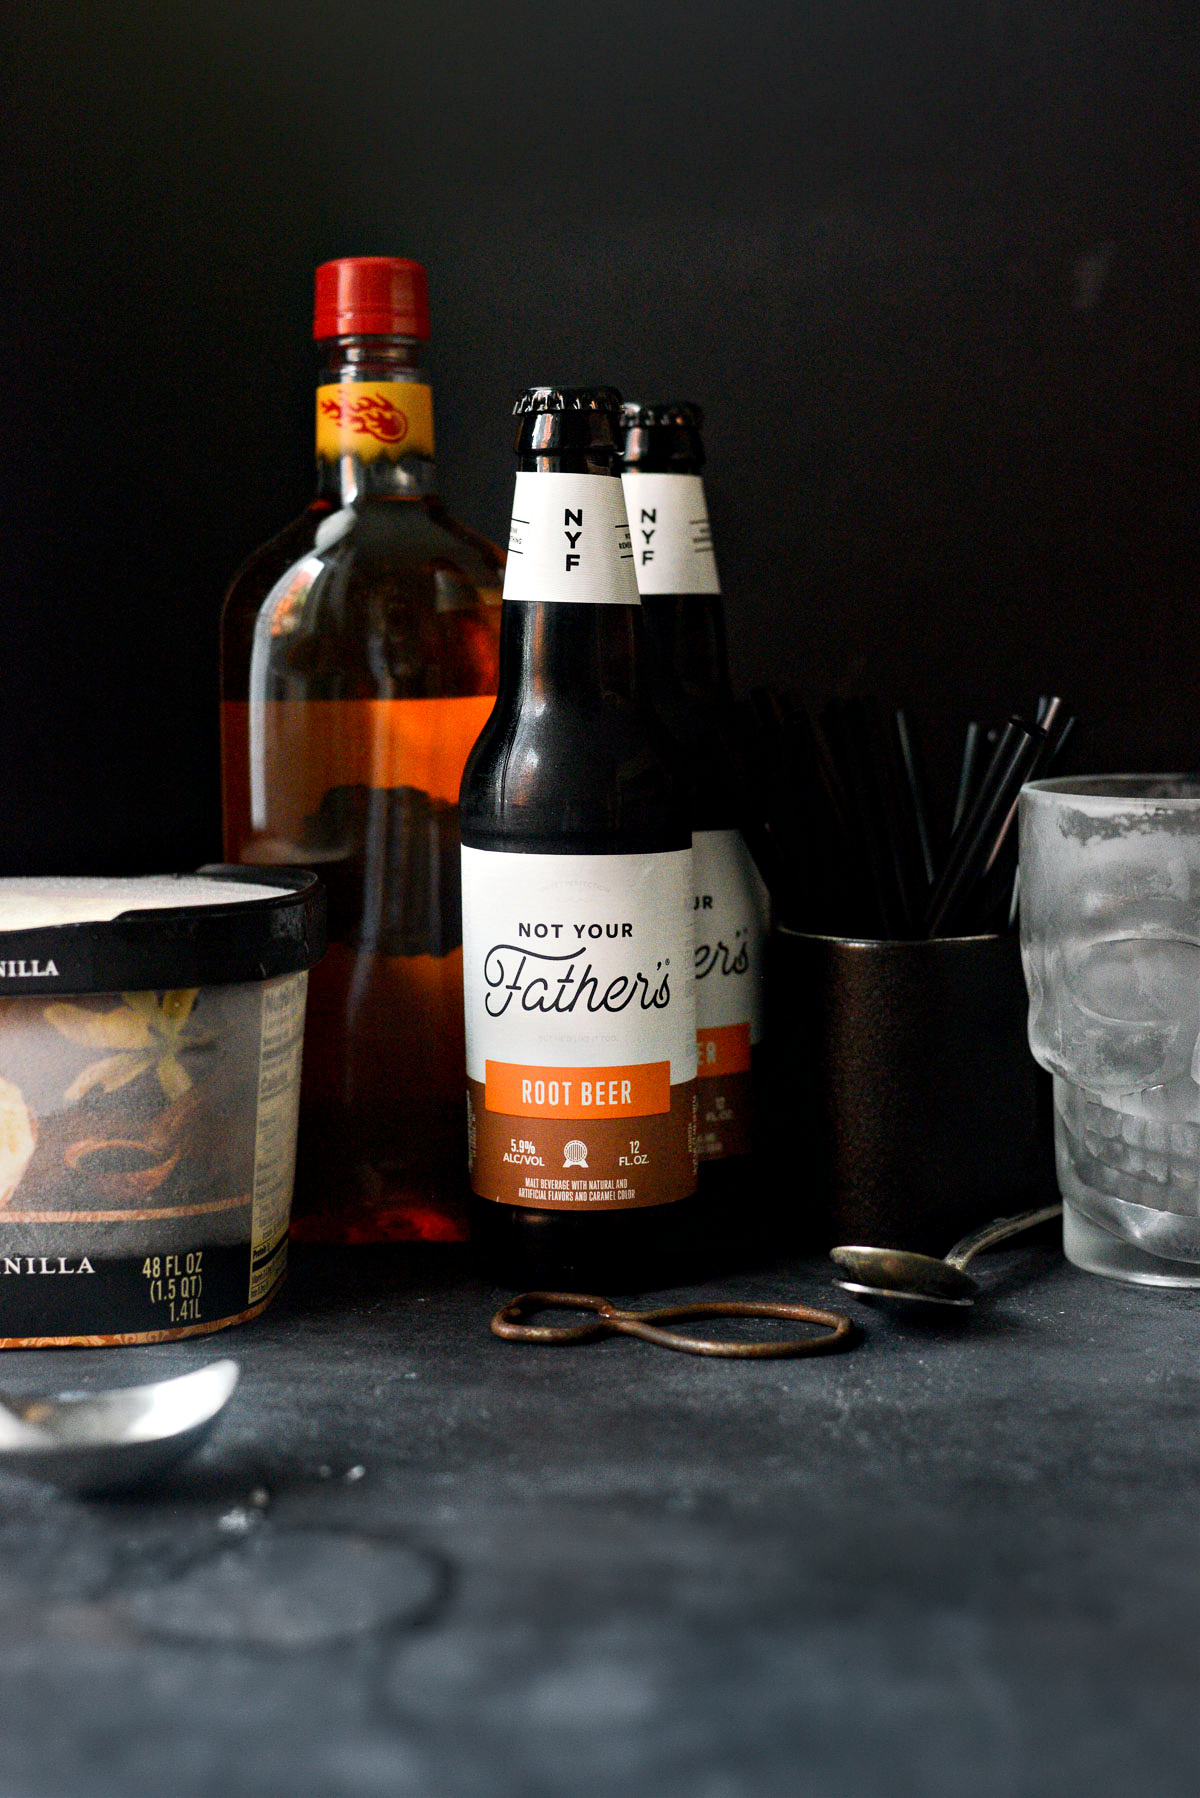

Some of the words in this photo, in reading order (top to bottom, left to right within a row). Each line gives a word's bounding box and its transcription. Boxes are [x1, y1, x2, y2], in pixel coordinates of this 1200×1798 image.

[518, 922, 563, 938] NOT
[573, 923, 633, 939] YOUR
[484, 944, 671, 1017] Father's
[522, 1079, 572, 1106] ROOT
[581, 1080, 632, 1106] BEER
[510, 1138, 536, 1154] 5.9%
[629, 1140, 640, 1154] 12
[503, 1152, 545, 1167] ALC/VOL
[525, 1177, 539, 1188] MALT
[541, 1179, 570, 1190] BEVERAGE
[571, 1180, 587, 1191] WITH
[589, 1179, 615, 1190] NATURAL
[616, 1178, 628, 1189] AND
[518, 1187, 547, 1200] ARTIFICIAL
[548, 1190, 573, 1201] FLAVORS
[575, 1191, 587, 1201] AND
[589, 1190, 616, 1201] CARAMEL
[618, 1189, 635, 1200] COLOR
[0, 1256, 96, 1275] NILLA
[142, 1257, 161, 1278] 48
[165, 1255, 182, 1277] FL
[186, 1252, 203, 1274] OZ
[150, 1279, 176, 1303] (1.5
[181, 1275, 202, 1299] QT)
[169, 1299, 202, 1322] 1.41L
